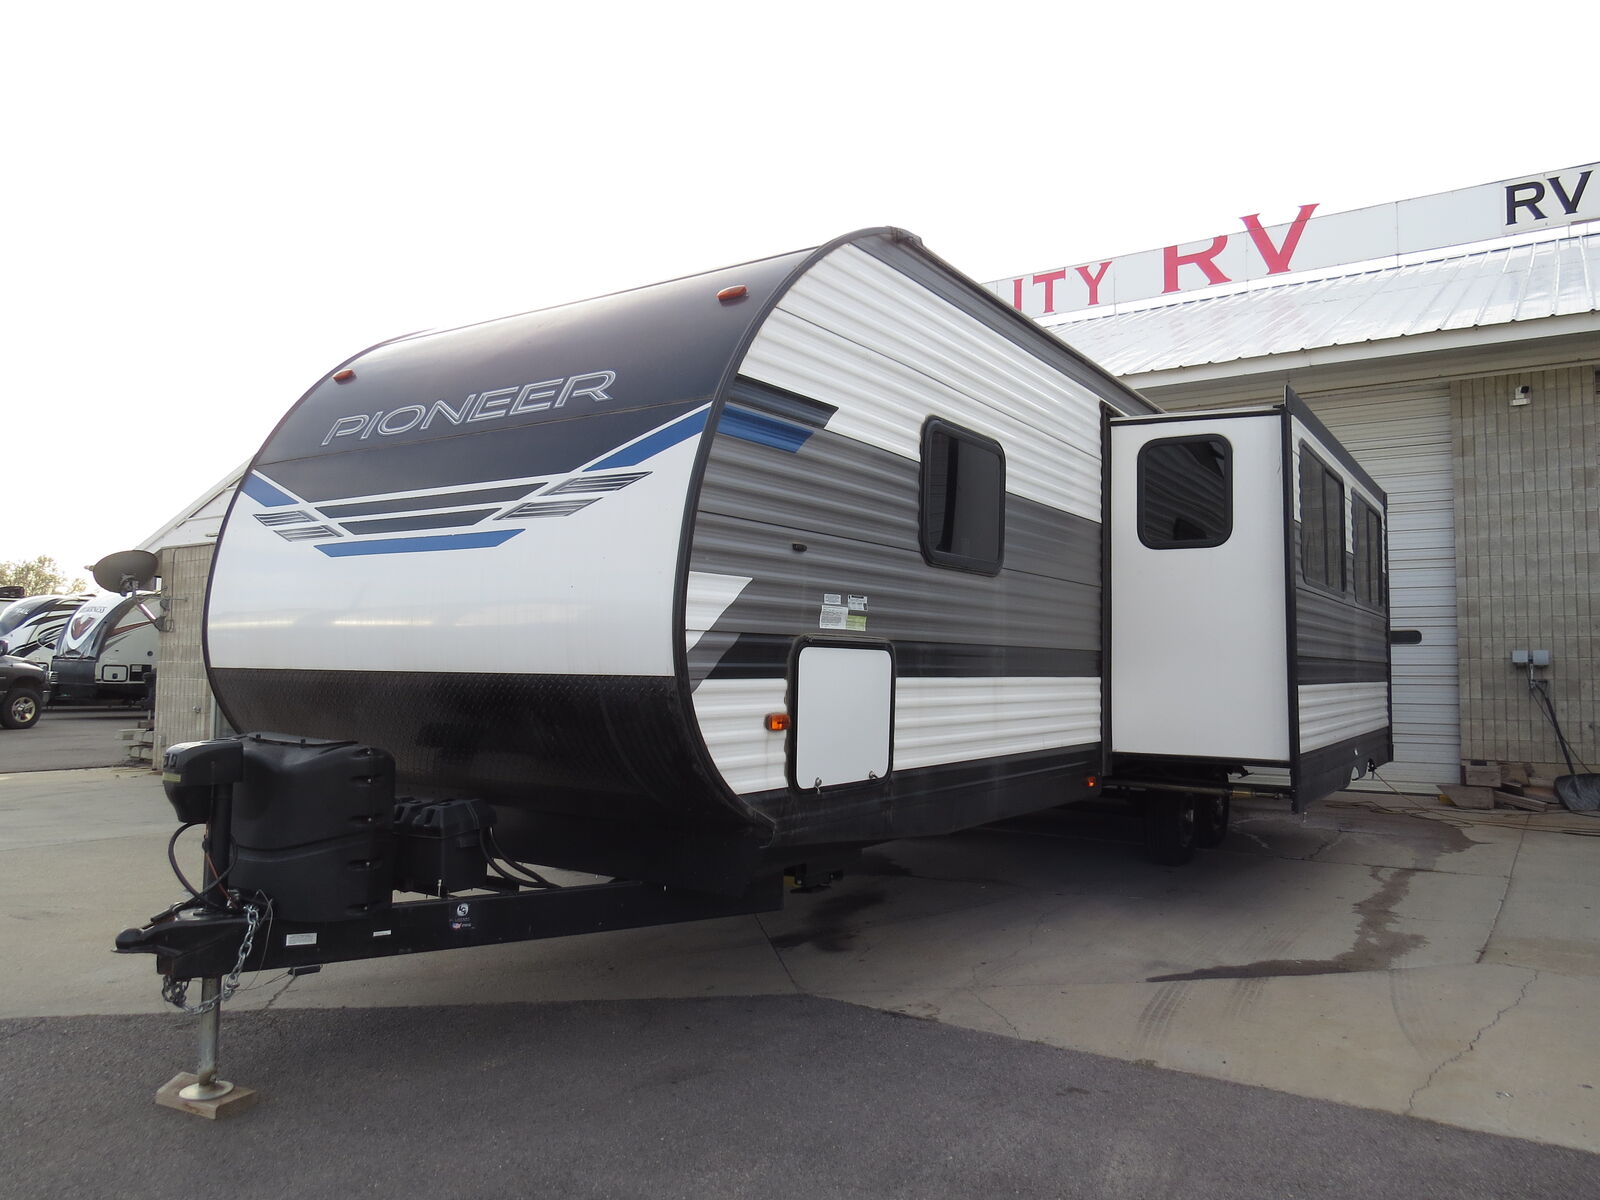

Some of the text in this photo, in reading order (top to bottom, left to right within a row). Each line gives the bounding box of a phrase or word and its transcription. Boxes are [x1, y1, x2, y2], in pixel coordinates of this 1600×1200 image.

[1505, 170, 1593, 225] RV
[1161, 203, 1320, 294] RV
[321, 370, 616, 446] PIONEER
